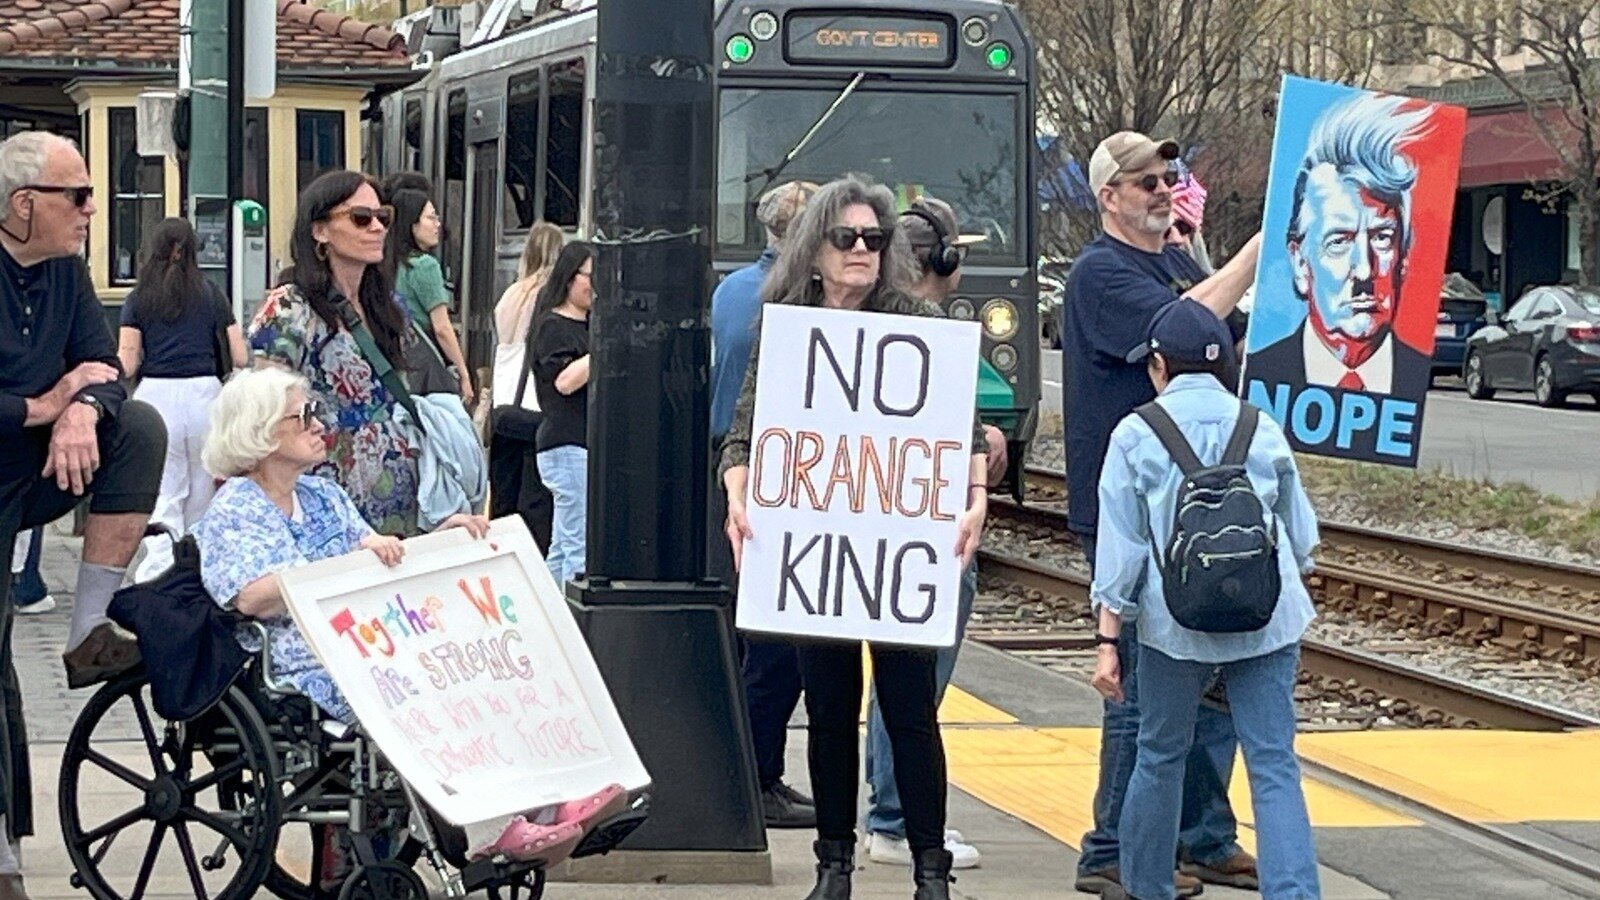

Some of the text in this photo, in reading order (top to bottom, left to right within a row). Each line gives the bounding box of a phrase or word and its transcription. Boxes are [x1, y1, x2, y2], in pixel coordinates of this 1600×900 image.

[872, 30, 939, 49] CENTER
[803, 327, 931, 417] NO
[1247, 379, 1418, 457] NOPE
[752, 427, 963, 522] ORANGE
[777, 531, 938, 624] KING
[329, 576, 518, 659] Together We
[418, 628, 535, 691] STRONG
[553, 678, 574, 706] A
[512, 715, 599, 760] FUTURE
